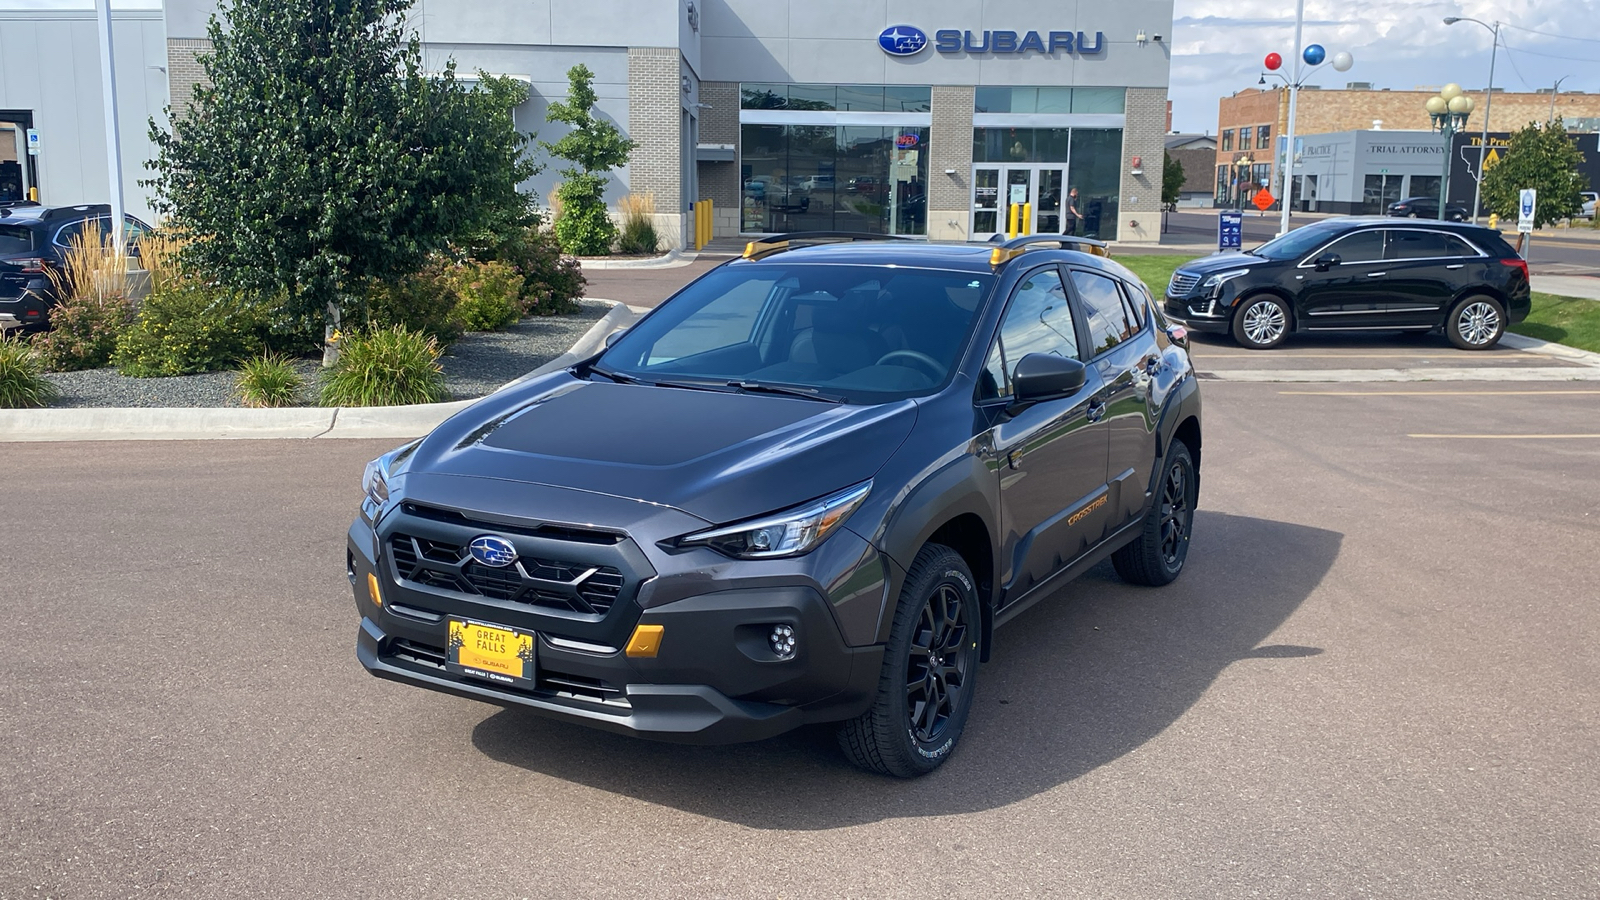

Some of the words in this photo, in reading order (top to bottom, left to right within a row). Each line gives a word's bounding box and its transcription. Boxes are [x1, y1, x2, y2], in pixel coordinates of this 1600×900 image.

[935, 29, 1103, 54] SUBARU
[896, 135, 917, 145] OPEN
[1471, 137, 1488, 146] Th
[1490, 137, 1513, 146] Prac
[1370, 145, 1398, 154] TRIAL
[1400, 146, 1445, 154] ATTORNEY
[1067, 494, 1108, 526] CROSSTREK
[476, 630, 506, 643] GREAT
[476, 640, 506, 653] FALLS
[482, 660, 509, 669] SUBARU
